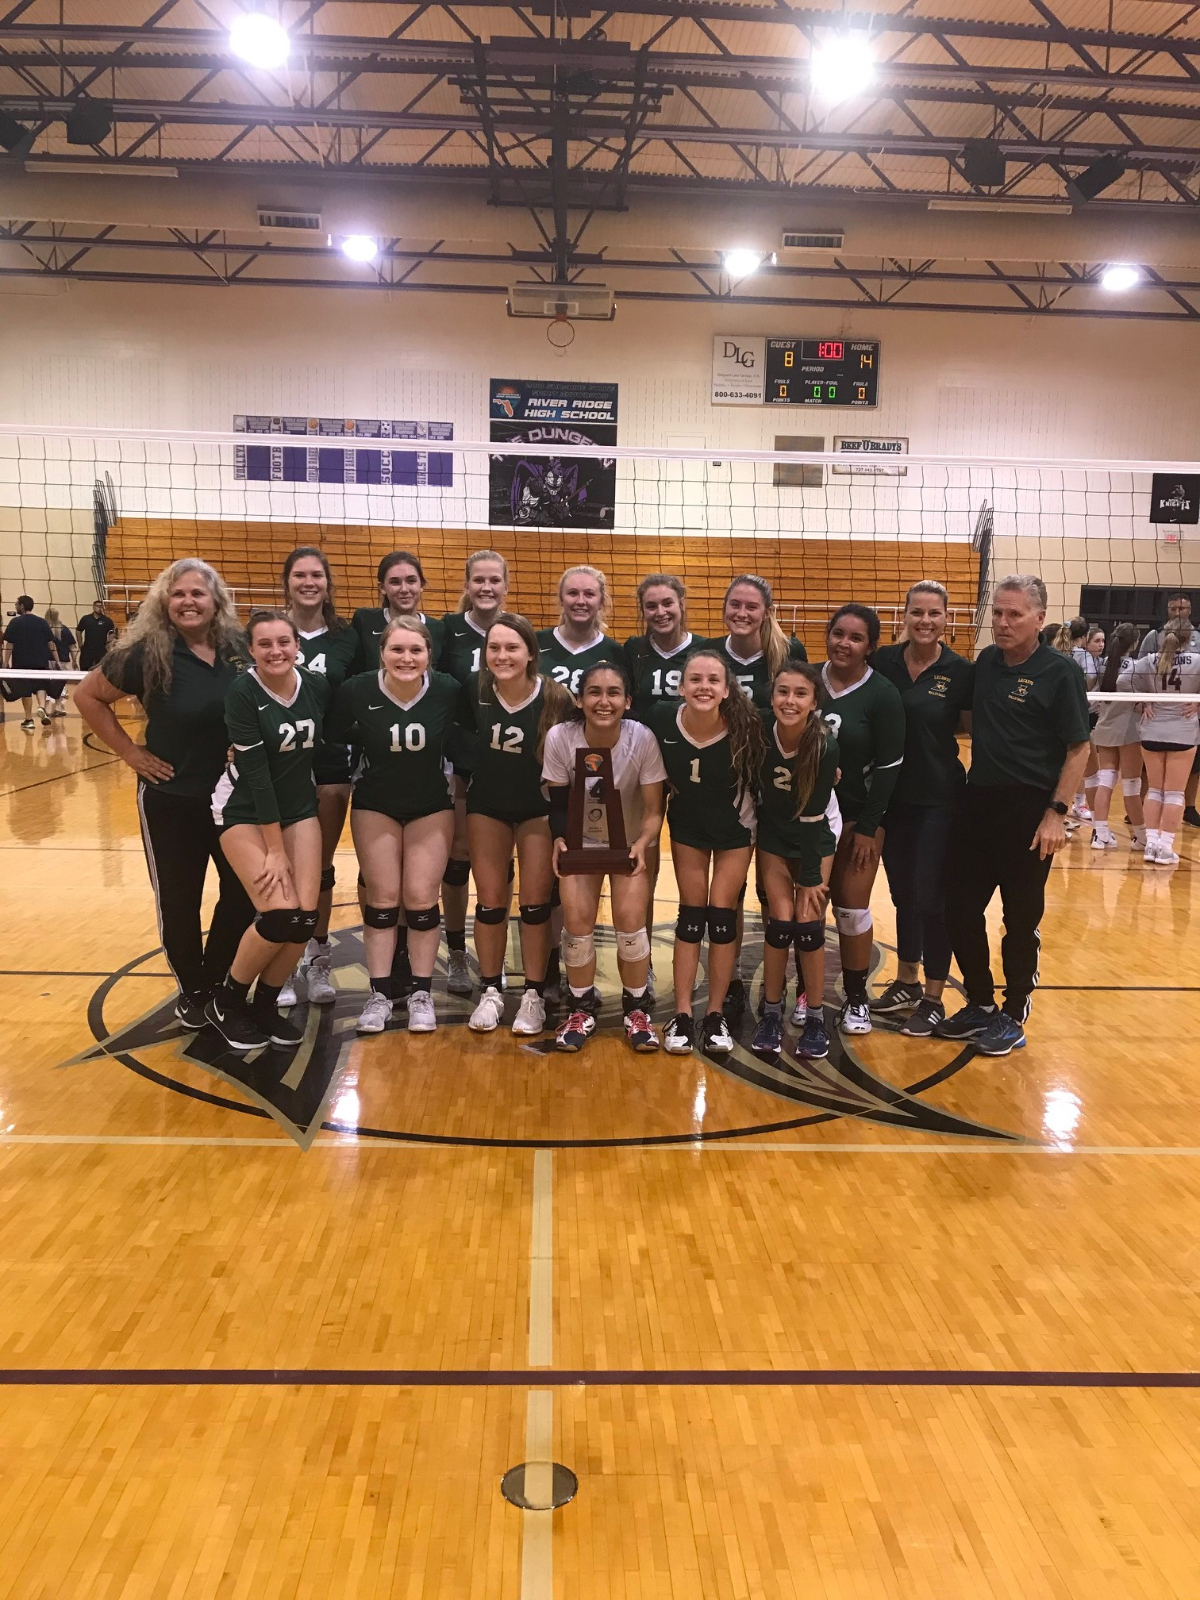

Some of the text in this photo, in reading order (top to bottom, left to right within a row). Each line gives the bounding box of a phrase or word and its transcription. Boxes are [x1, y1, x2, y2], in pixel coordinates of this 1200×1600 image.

[722, 341, 756, 368] DLG
[770, 341, 797, 349] GUEST
[818, 342, 843, 358] 1:00
[850, 343, 875, 351] HOME
[784, 351, 794, 367] 8
[860, 353, 873, 369] 14
[779, 385, 787, 397] 0
[858, 387, 866, 399] 0
[527, 398, 613, 409] RIVER RIDGE
[524, 408, 615, 420] HIGH SCHOOL
[840, 441, 862, 450] BEEF
[381, 432, 391, 484] SOCCR
[417, 461, 427, 485] GIRLS
[651, 668, 683, 697] 19
[1161, 668, 1182, 691] 14
[278, 718, 316, 753] 27
[389, 722, 426, 752] 10
[489, 722, 525, 754] 12
[689, 758, 701, 783] 1
[773, 765, 792, 792] 2
